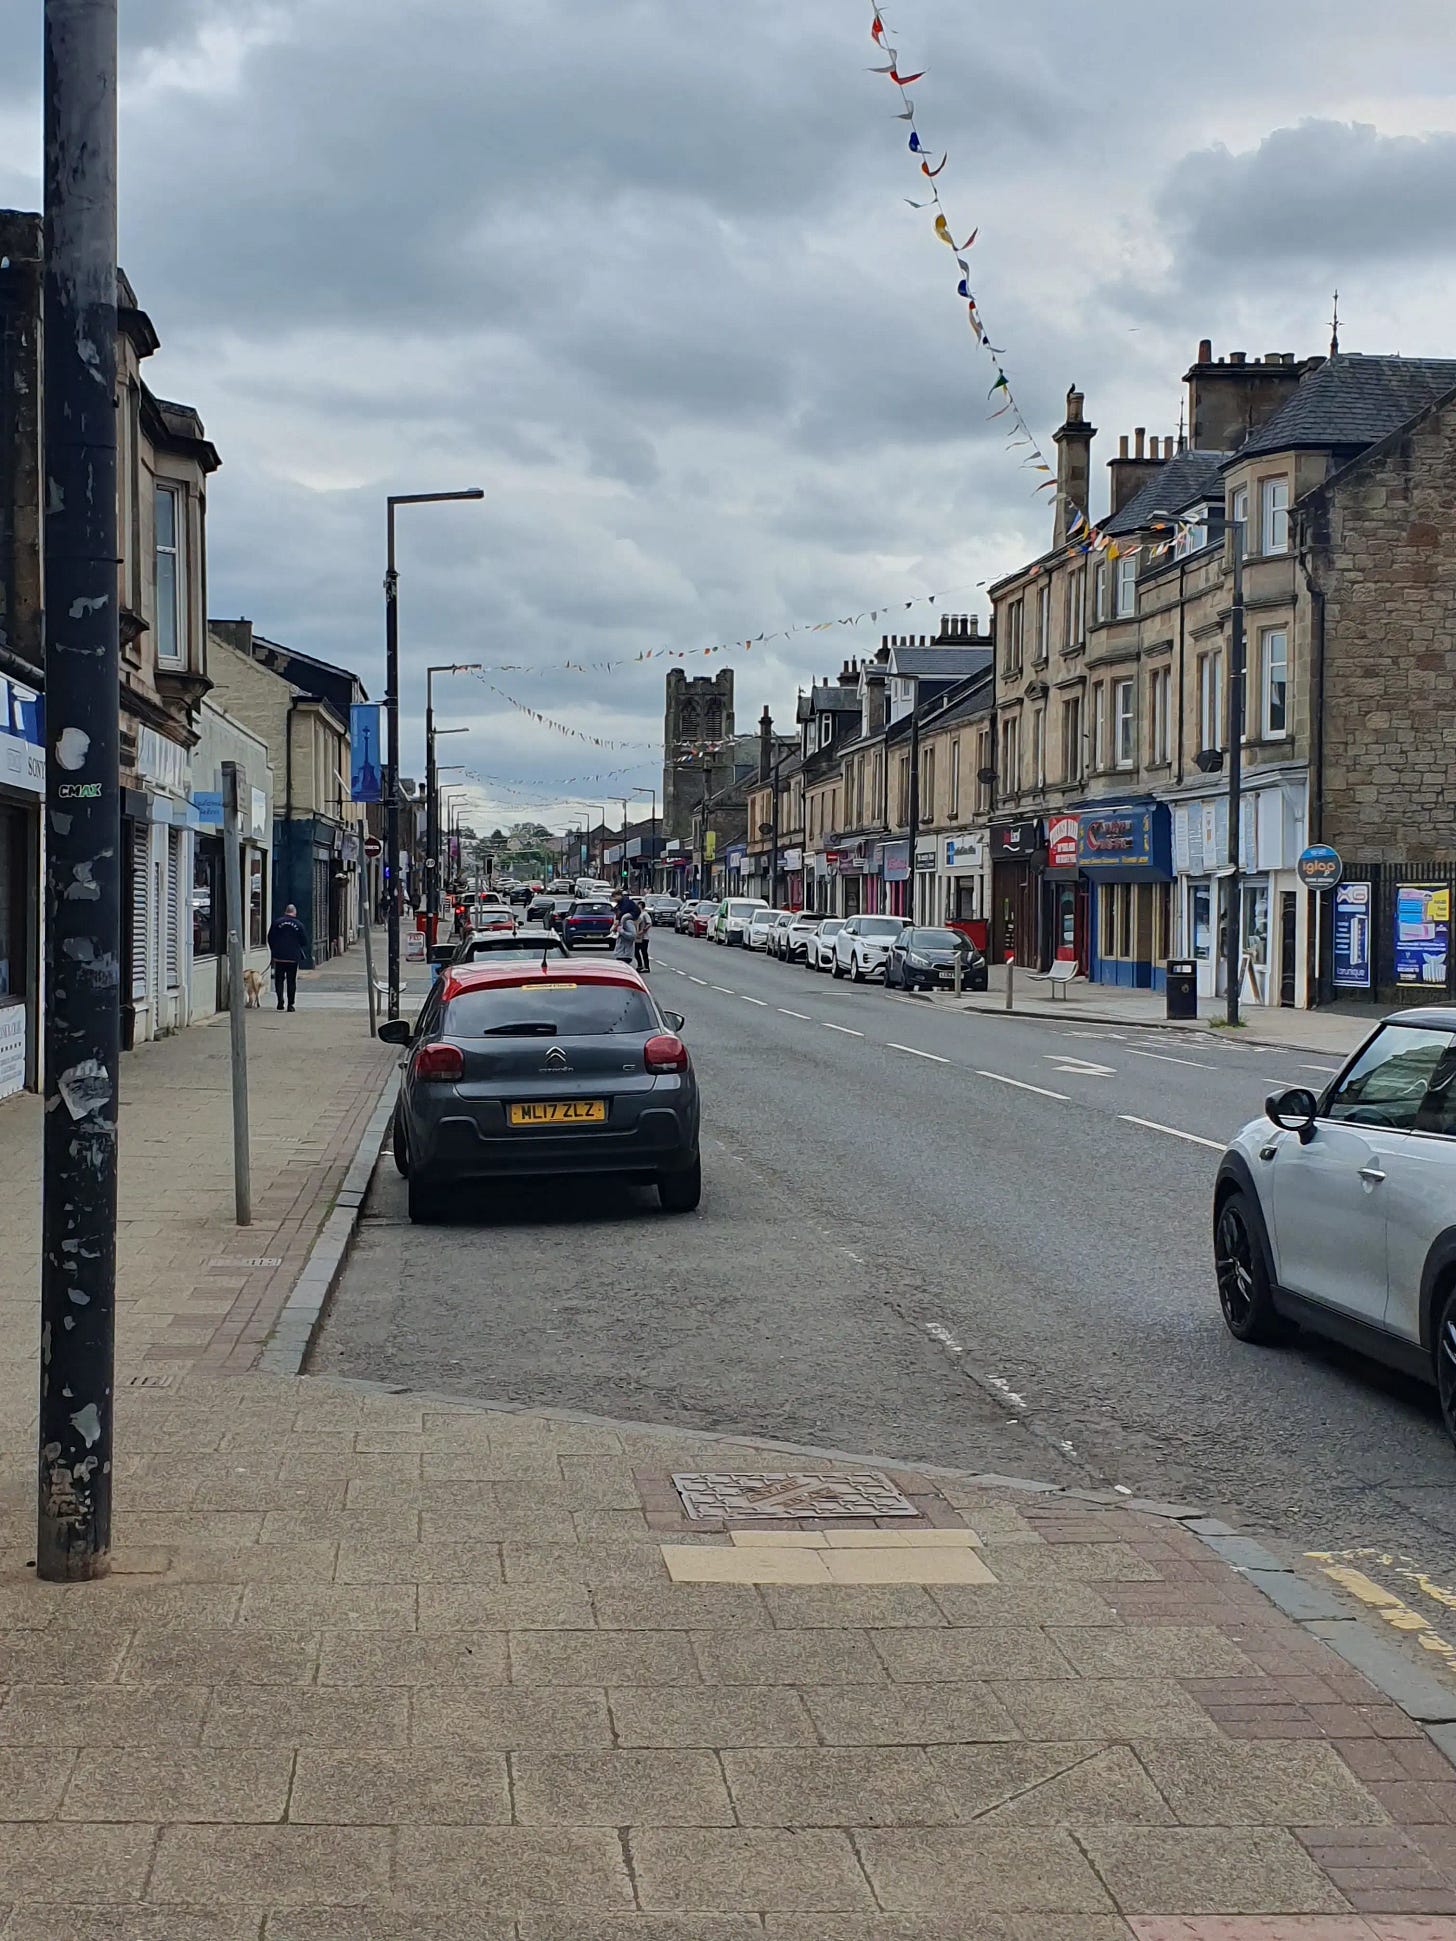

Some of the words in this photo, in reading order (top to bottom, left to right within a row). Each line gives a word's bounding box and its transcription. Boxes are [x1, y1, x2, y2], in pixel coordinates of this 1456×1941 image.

[59, 783, 102, 798] CMAX
[1302, 860, 1336, 873] igloo
[521, 1103, 558, 1120] ML17
[563, 1102, 595, 1118] ZLZ
